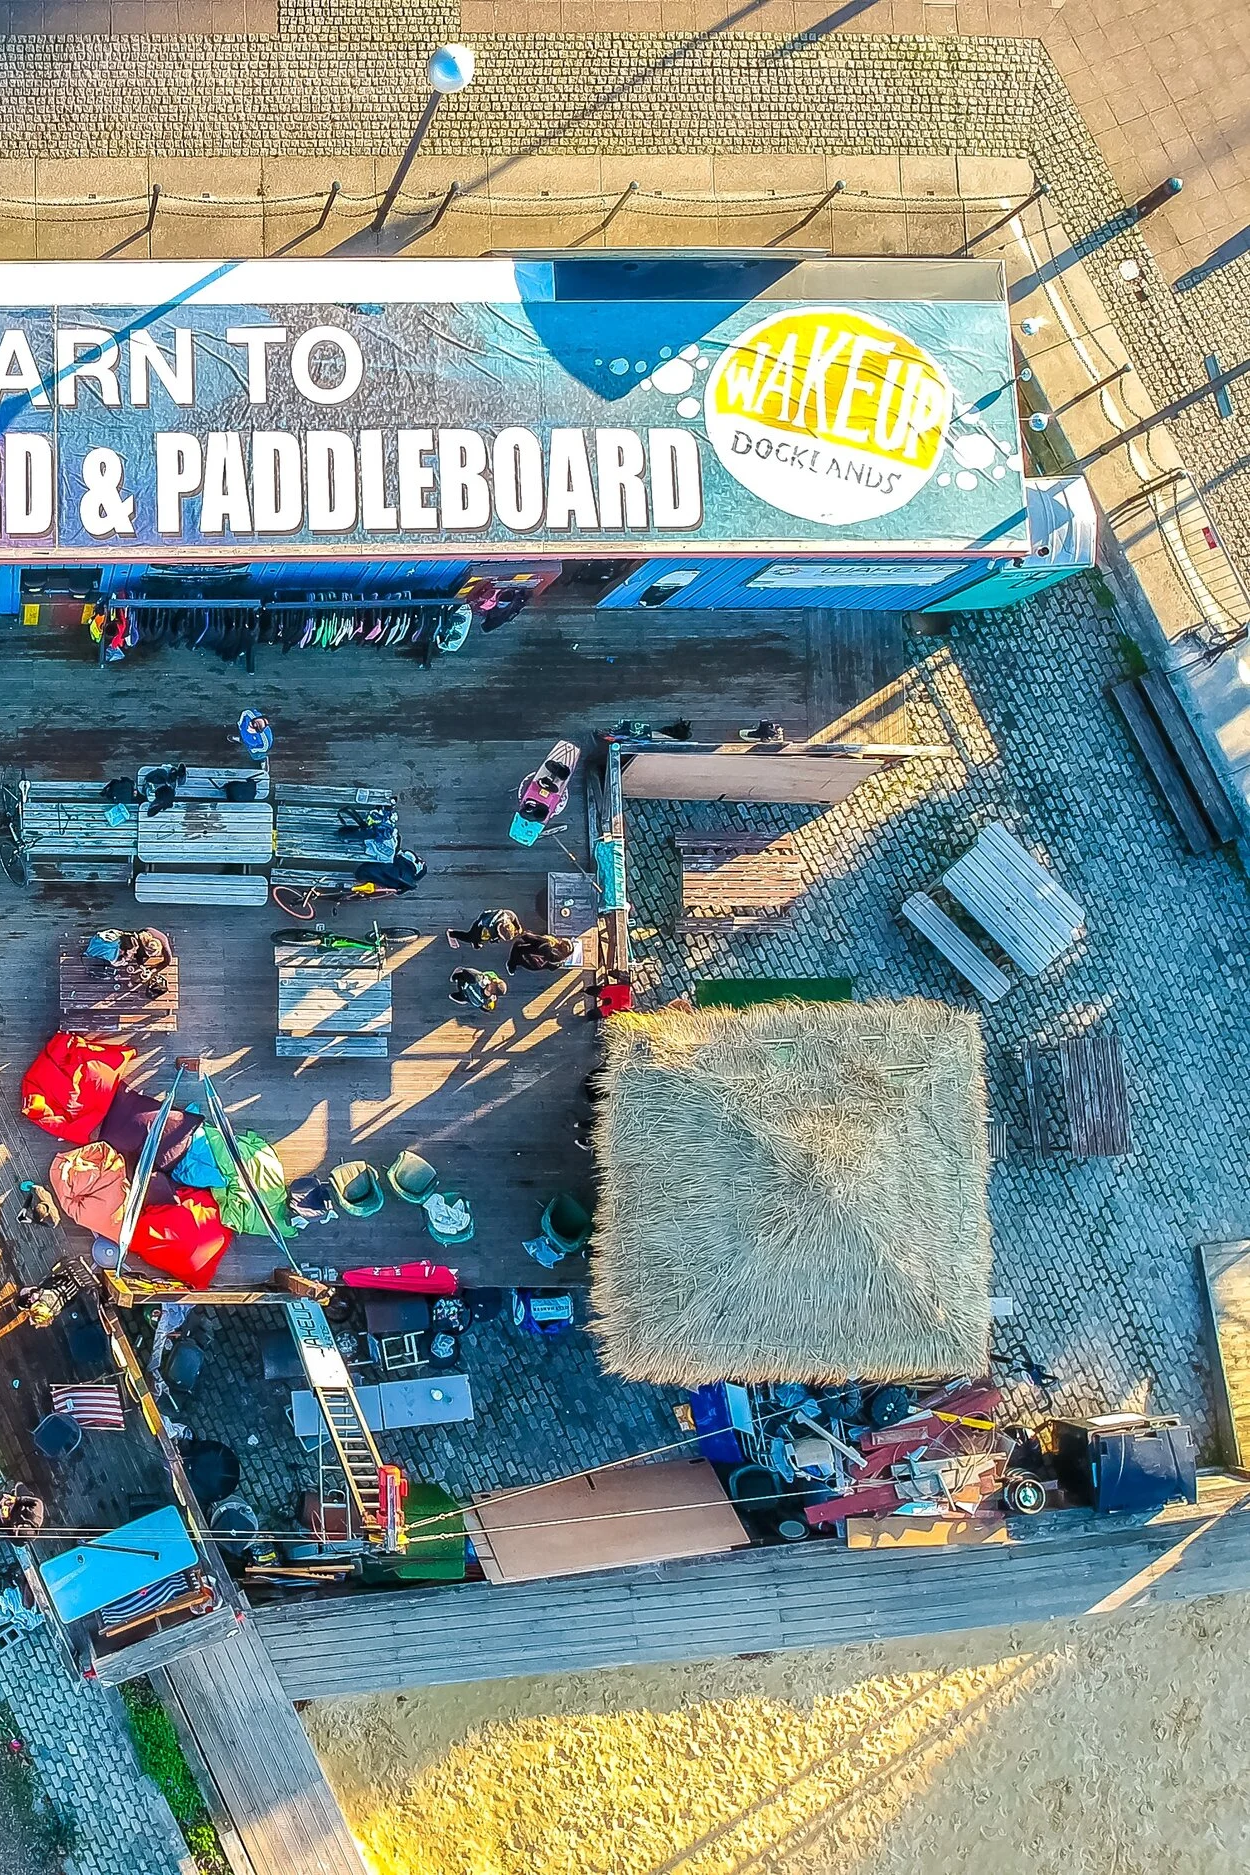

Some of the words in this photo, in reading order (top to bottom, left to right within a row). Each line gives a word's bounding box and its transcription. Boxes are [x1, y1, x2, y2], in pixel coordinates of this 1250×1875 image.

[226, 324, 365, 408] TO
[726, 325, 950, 460] WAKEUP
[78, 446, 137, 540] &
[156, 425, 704, 538] PADDLEBOARD
[731, 430, 902, 495] DOCKLANDS
[820, 565, 963, 574] WAKEUP
